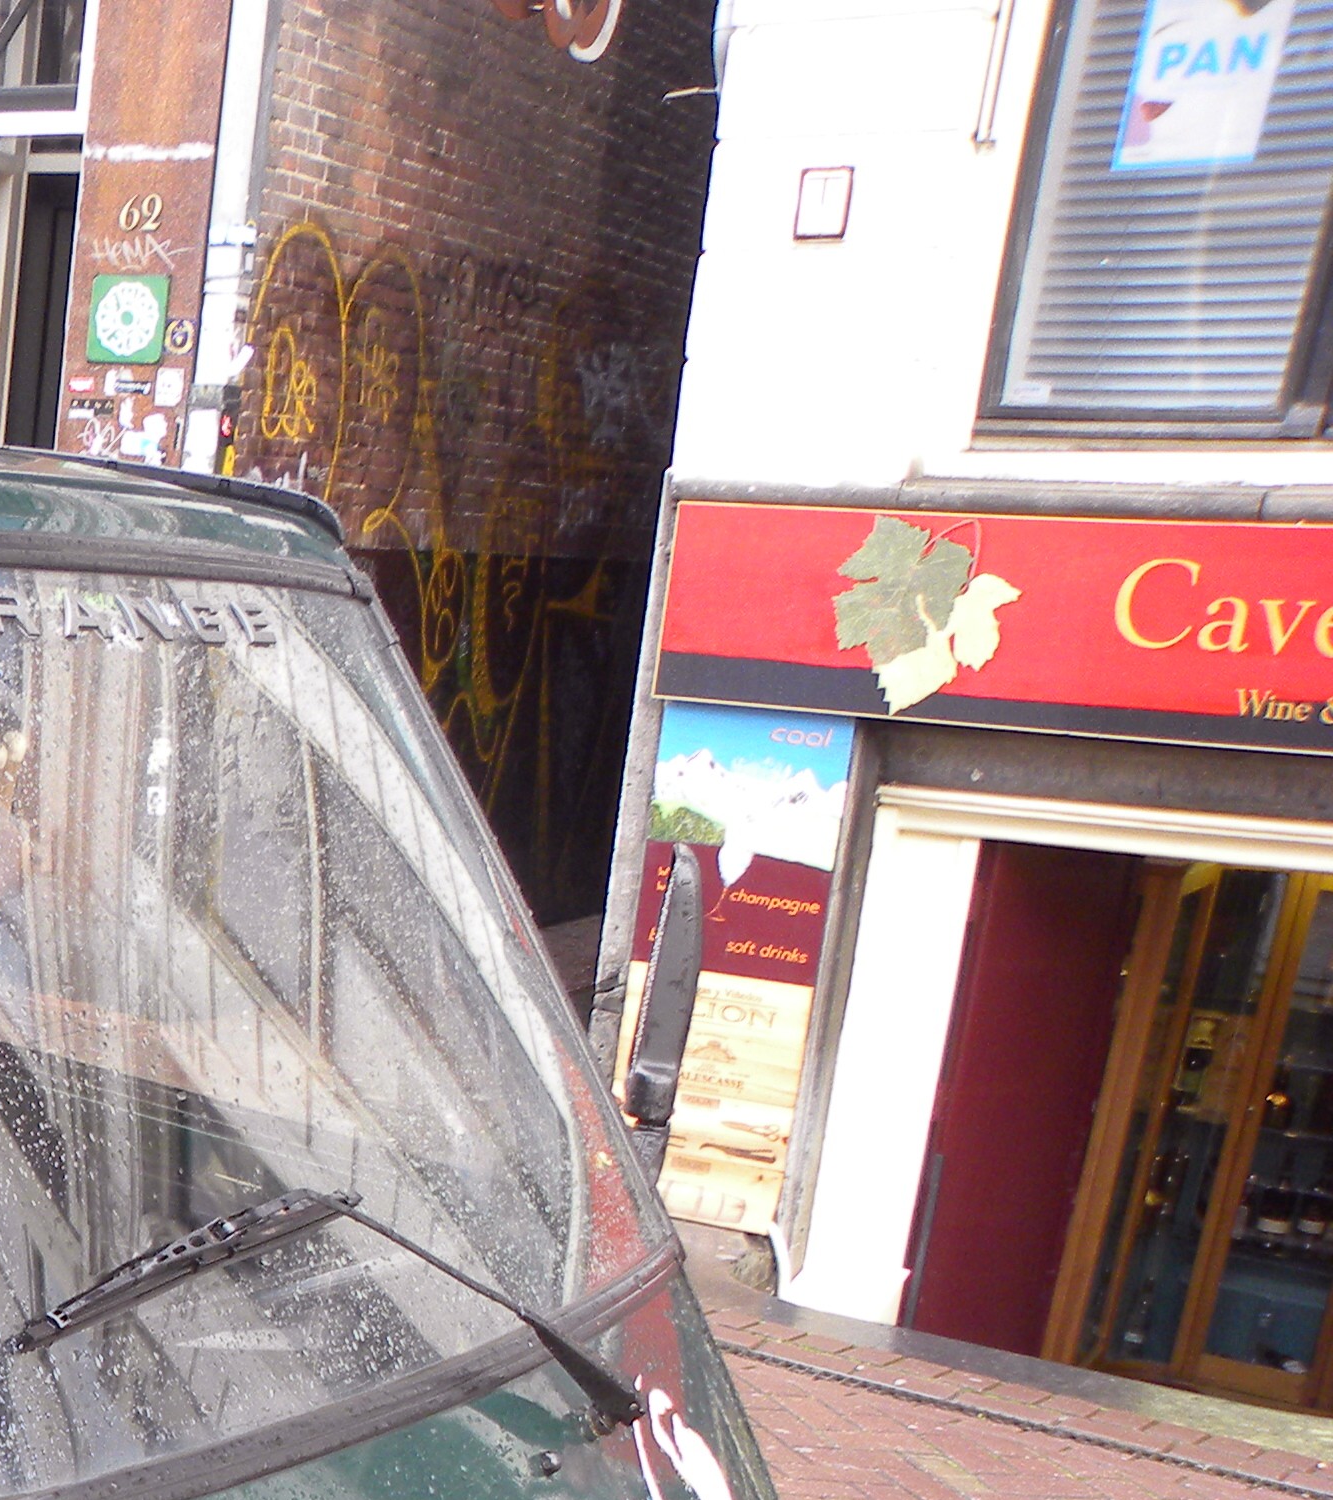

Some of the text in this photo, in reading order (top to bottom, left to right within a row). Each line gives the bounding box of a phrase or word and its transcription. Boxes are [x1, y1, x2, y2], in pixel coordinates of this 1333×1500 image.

[118, 192, 164, 233] 62
[1235, 687, 1314, 723] Wine
[770, 727, 834, 748] cool
[728, 888, 822, 916] champagne
[725, 939, 809, 965] soft drinks
[678, 1071, 745, 1092] ALESCASSE
